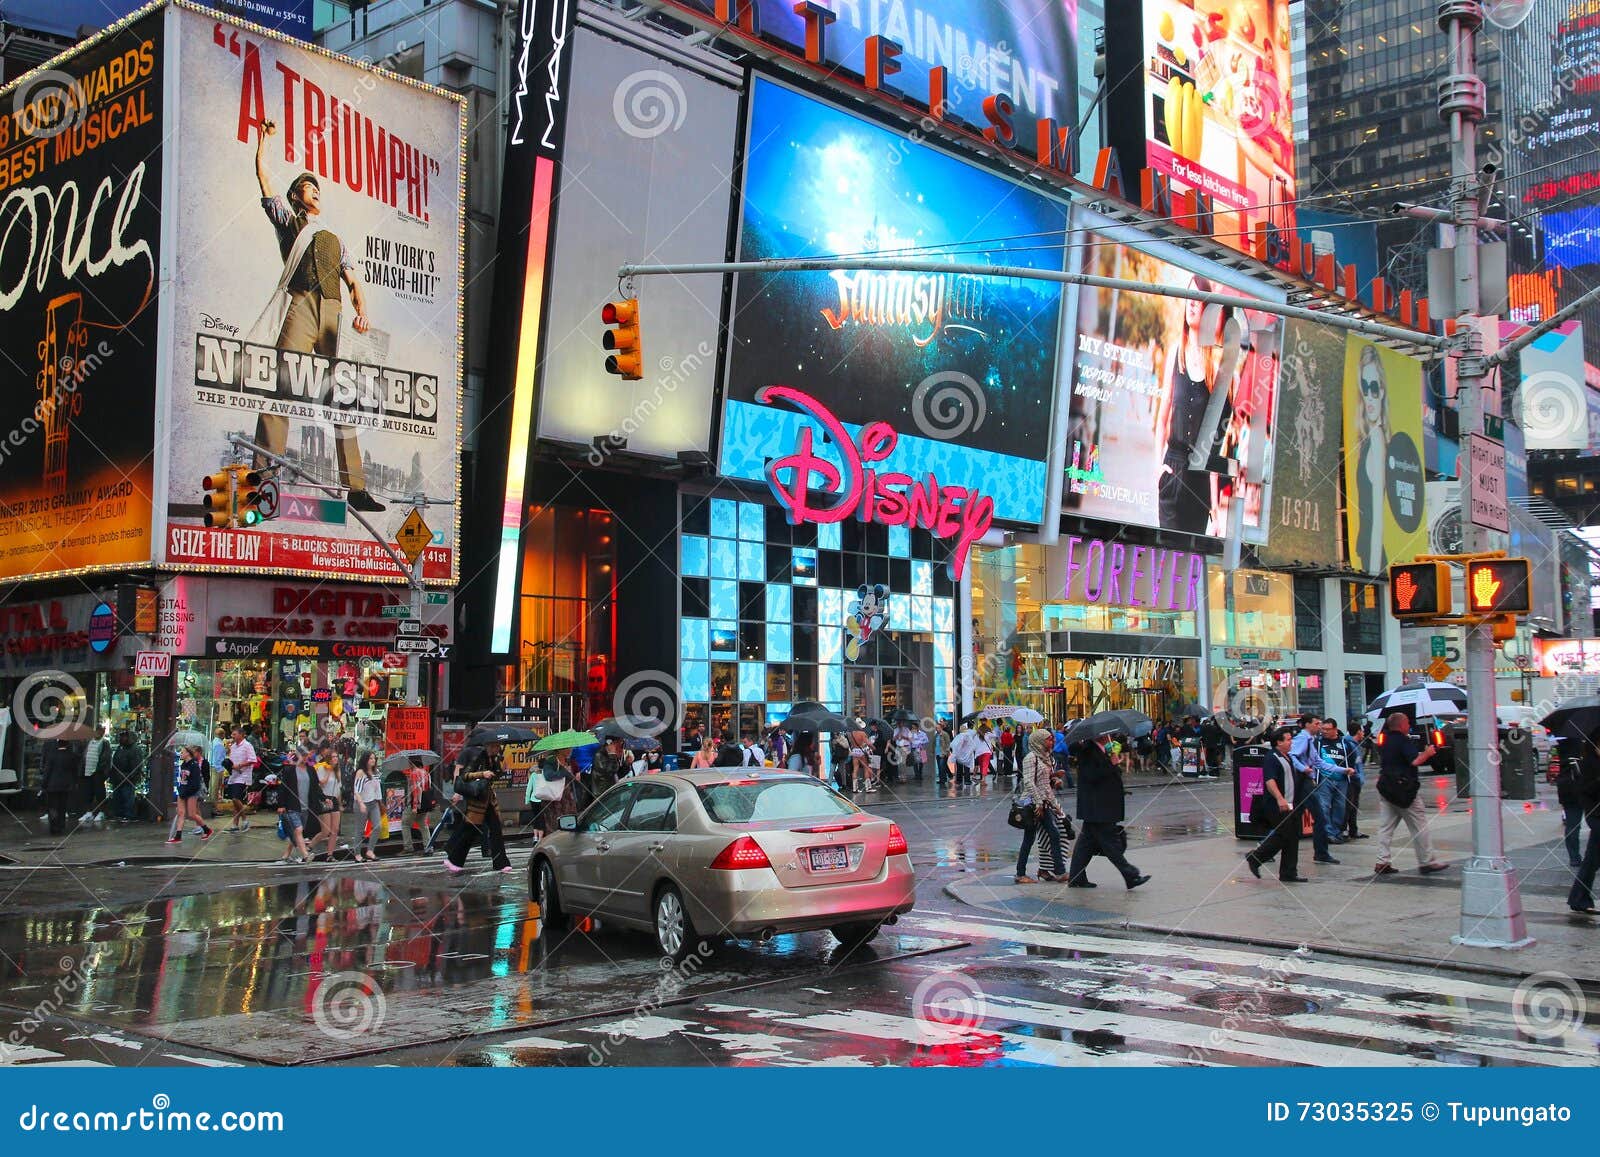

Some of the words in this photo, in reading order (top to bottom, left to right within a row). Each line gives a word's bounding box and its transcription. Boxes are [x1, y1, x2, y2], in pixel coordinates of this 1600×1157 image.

[0, 115, 10, 150] 8
[12, 88, 63, 141] TONY
[64, 40, 155, 118] AWARDS
[0, 139, 49, 192] BEST
[55, 90, 153, 165] MUSICAL
[1172, 158, 1186, 177] For
[1187, 164, 1203, 185] less
[1203, 173, 1231, 198] kitchen
[1232, 188, 1249, 207] time
[397, 210, 429, 229] Bloomberg
[366, 235, 391, 262] NEW
[395, 242, 435, 273] YORK'S
[417, 296, 434, 304] NEWS
[1078, 333, 1102, 356] MY
[198, 335, 438, 419] NEWSIES
[197, 390, 226, 406] THE
[230, 395, 266, 411] TONY
[382, 419, 435, 436] MUSICAL
[1485, 415, 1492, 435] 7
[1472, 445, 1489, 465] RIGHT
[1490, 454, 1504, 470] LANE
[1480, 473, 1498, 493] MUST
[29, 498, 49, 515] 2013
[51, 488, 93, 510] GRAMMY
[97, 480, 134, 500] AWARD
[0, 521, 13, 537] EST
[15, 515, 53, 533] MUSICAL
[55, 508, 93, 530] THEATER
[95, 501, 127, 521] ALBUM
[1281, 496, 1320, 532] USPA
[1472, 499, 1488, 515] TURN
[1490, 504, 1506, 520] RIGHT
[171, 529, 206, 558] SEIZE
[209, 532, 235, 560] THE
[237, 535, 261, 561] DAY
[282, 537, 289, 550] 5
[292, 539, 328, 554] BLOCKS
[330, 541, 361, 557] SOUTH
[362, 545, 372, 557] at
[428, 551, 447, 563] 41st
[1065, 536, 1202, 611] FOREVER
[160, 625, 185, 635] HOUR
[218, 615, 313, 637] CAMERAS
[322, 619, 337, 636] &
[151, 637, 182, 647] PHOTO
[229, 640, 259, 656] Apple
[272, 640, 320, 656] Nikon
[332, 642, 388, 657] Canon
[400, 640, 412, 648] ONE
[139, 656, 167, 670] ATM
[1104, 656, 1161, 681] FOREVER
[405, 710, 426, 720] STREET
